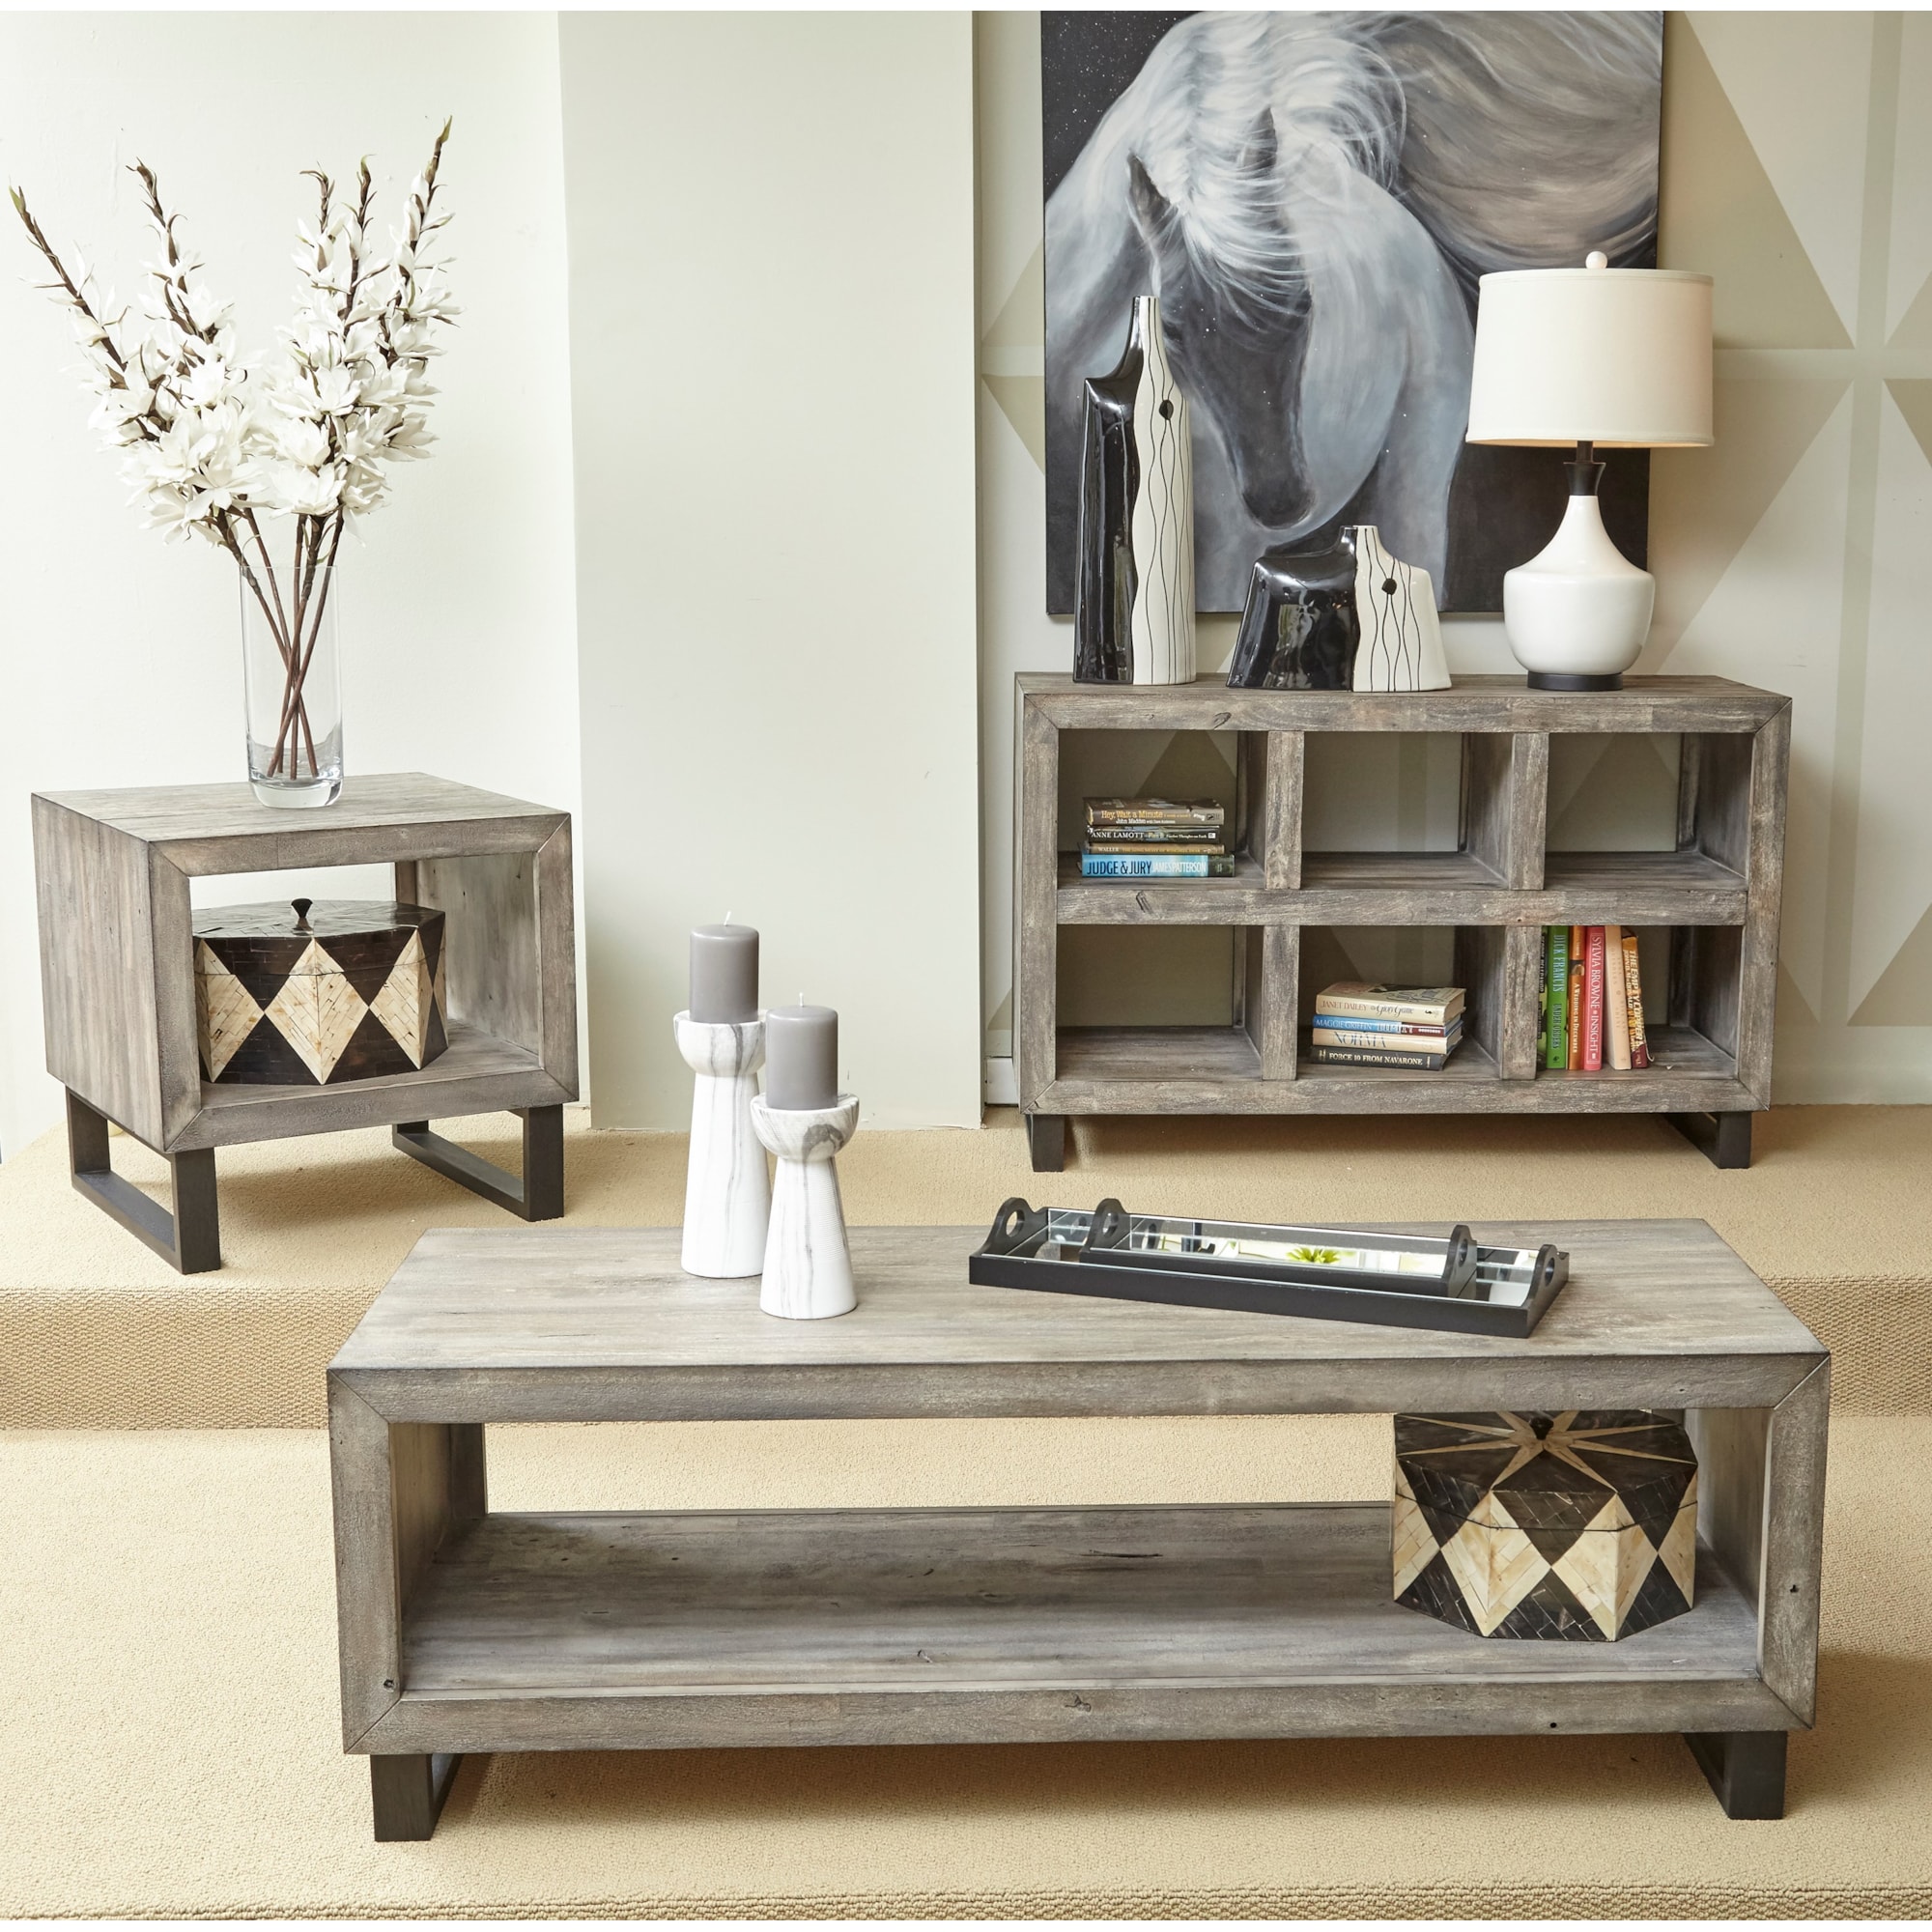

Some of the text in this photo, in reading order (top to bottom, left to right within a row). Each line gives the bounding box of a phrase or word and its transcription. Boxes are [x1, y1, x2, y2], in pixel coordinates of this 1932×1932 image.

[1138, 810, 1163, 818] Minute
[1087, 861, 1152, 875] JUDGE & JURY
[1152, 861, 1173, 873] JAMES
[1173, 861, 1207, 873] PATTERSON
[1552, 934, 1566, 992] DICK FRANCIS
[1629, 950, 1637, 968] THE
[1630, 969, 1640, 1001] EMPTY
[1590, 936, 1601, 1053] SYLVIA BROWNE INSIGHT
[1321, 1000, 1342, 1009] JANET
[1344, 1002, 1368, 1011] DAILEY
[1316, 1018, 1373, 1031] MAGGIE GRIFFIN
[1552, 1004, 1562, 1049] UNDER ORDERS
[1634, 1002, 1644, 1040] COPPER
[1333, 1031, 1387, 1048] NORMA
[1329, 1052, 1352, 1061] FORCE
[1383, 1056, 1423, 1065] NAVARONE
